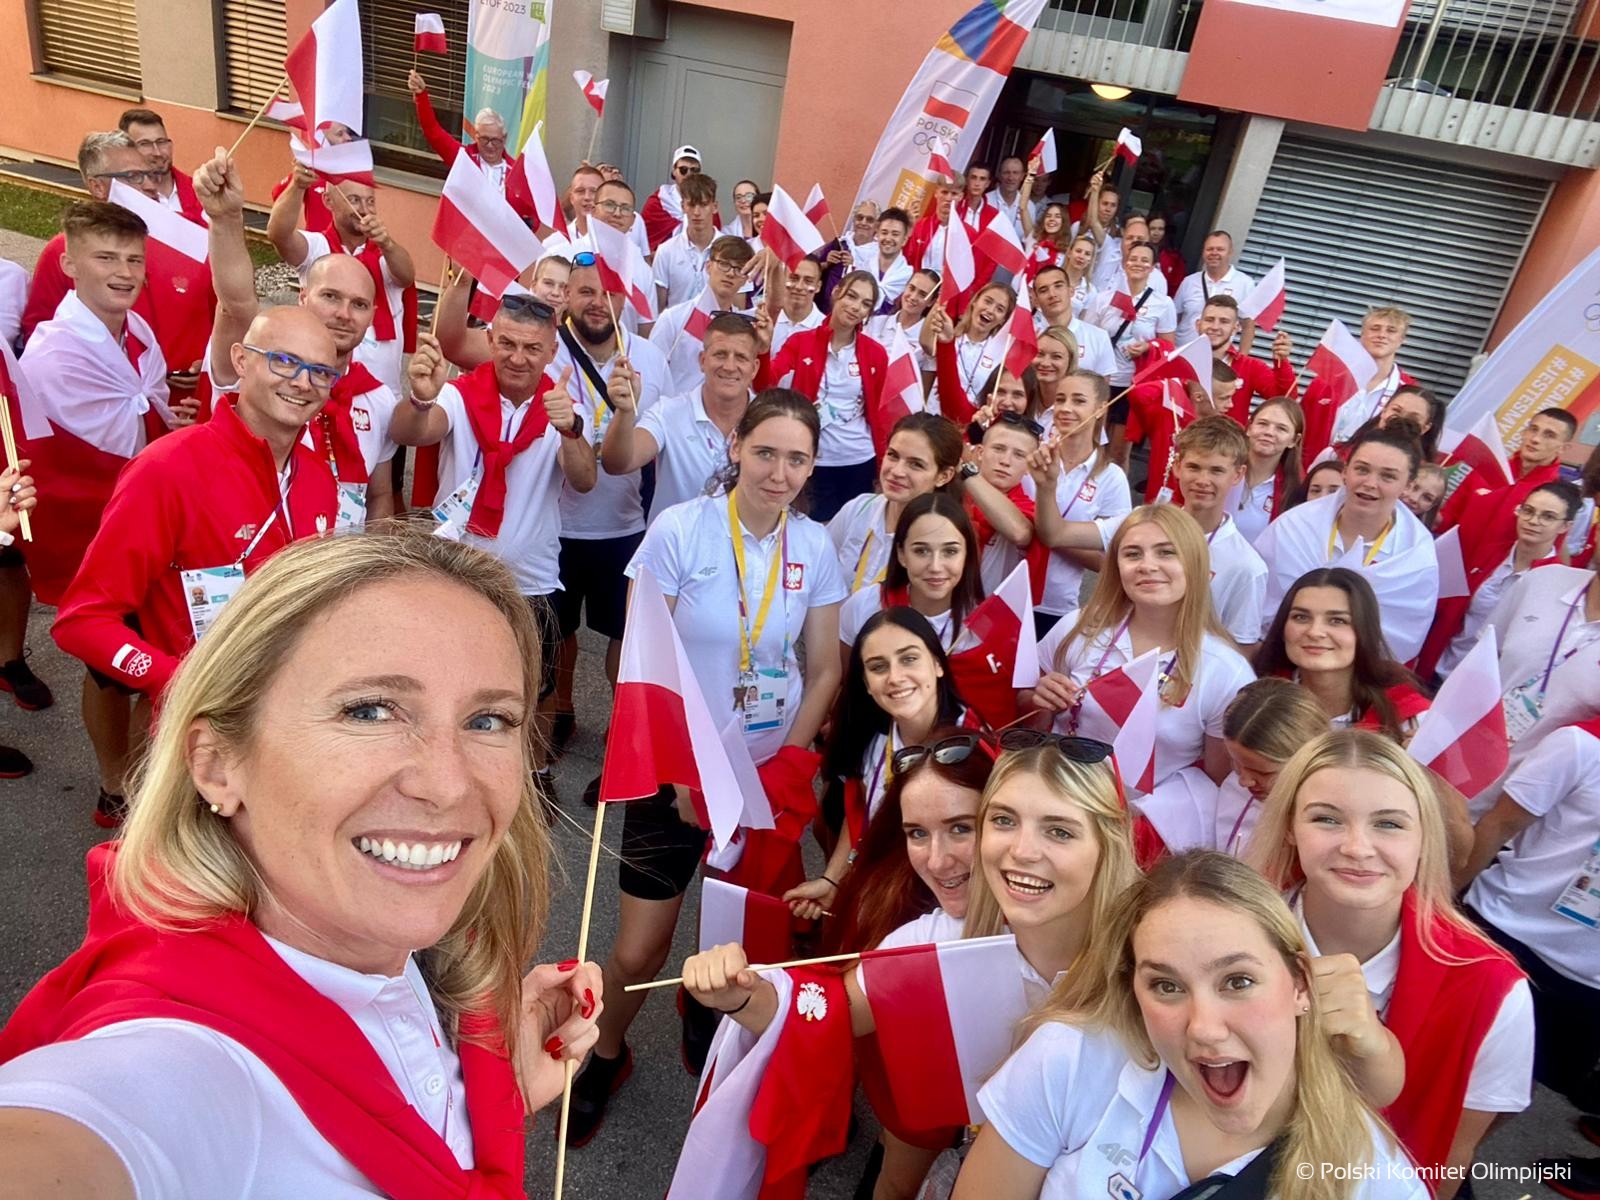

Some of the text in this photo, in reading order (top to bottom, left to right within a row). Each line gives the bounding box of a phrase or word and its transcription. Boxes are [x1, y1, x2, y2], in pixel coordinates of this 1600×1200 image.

[503, 2, 527, 15] 2023
[483, 64, 524, 78] EUROPEAN
[482, 74, 516, 87] OLYMPIC
[916, 117, 961, 144] POLSKA
[234, 524, 257, 540] 4F
[698, 566, 719, 577] 4F
[1096, 1142, 1138, 1167] 4F
